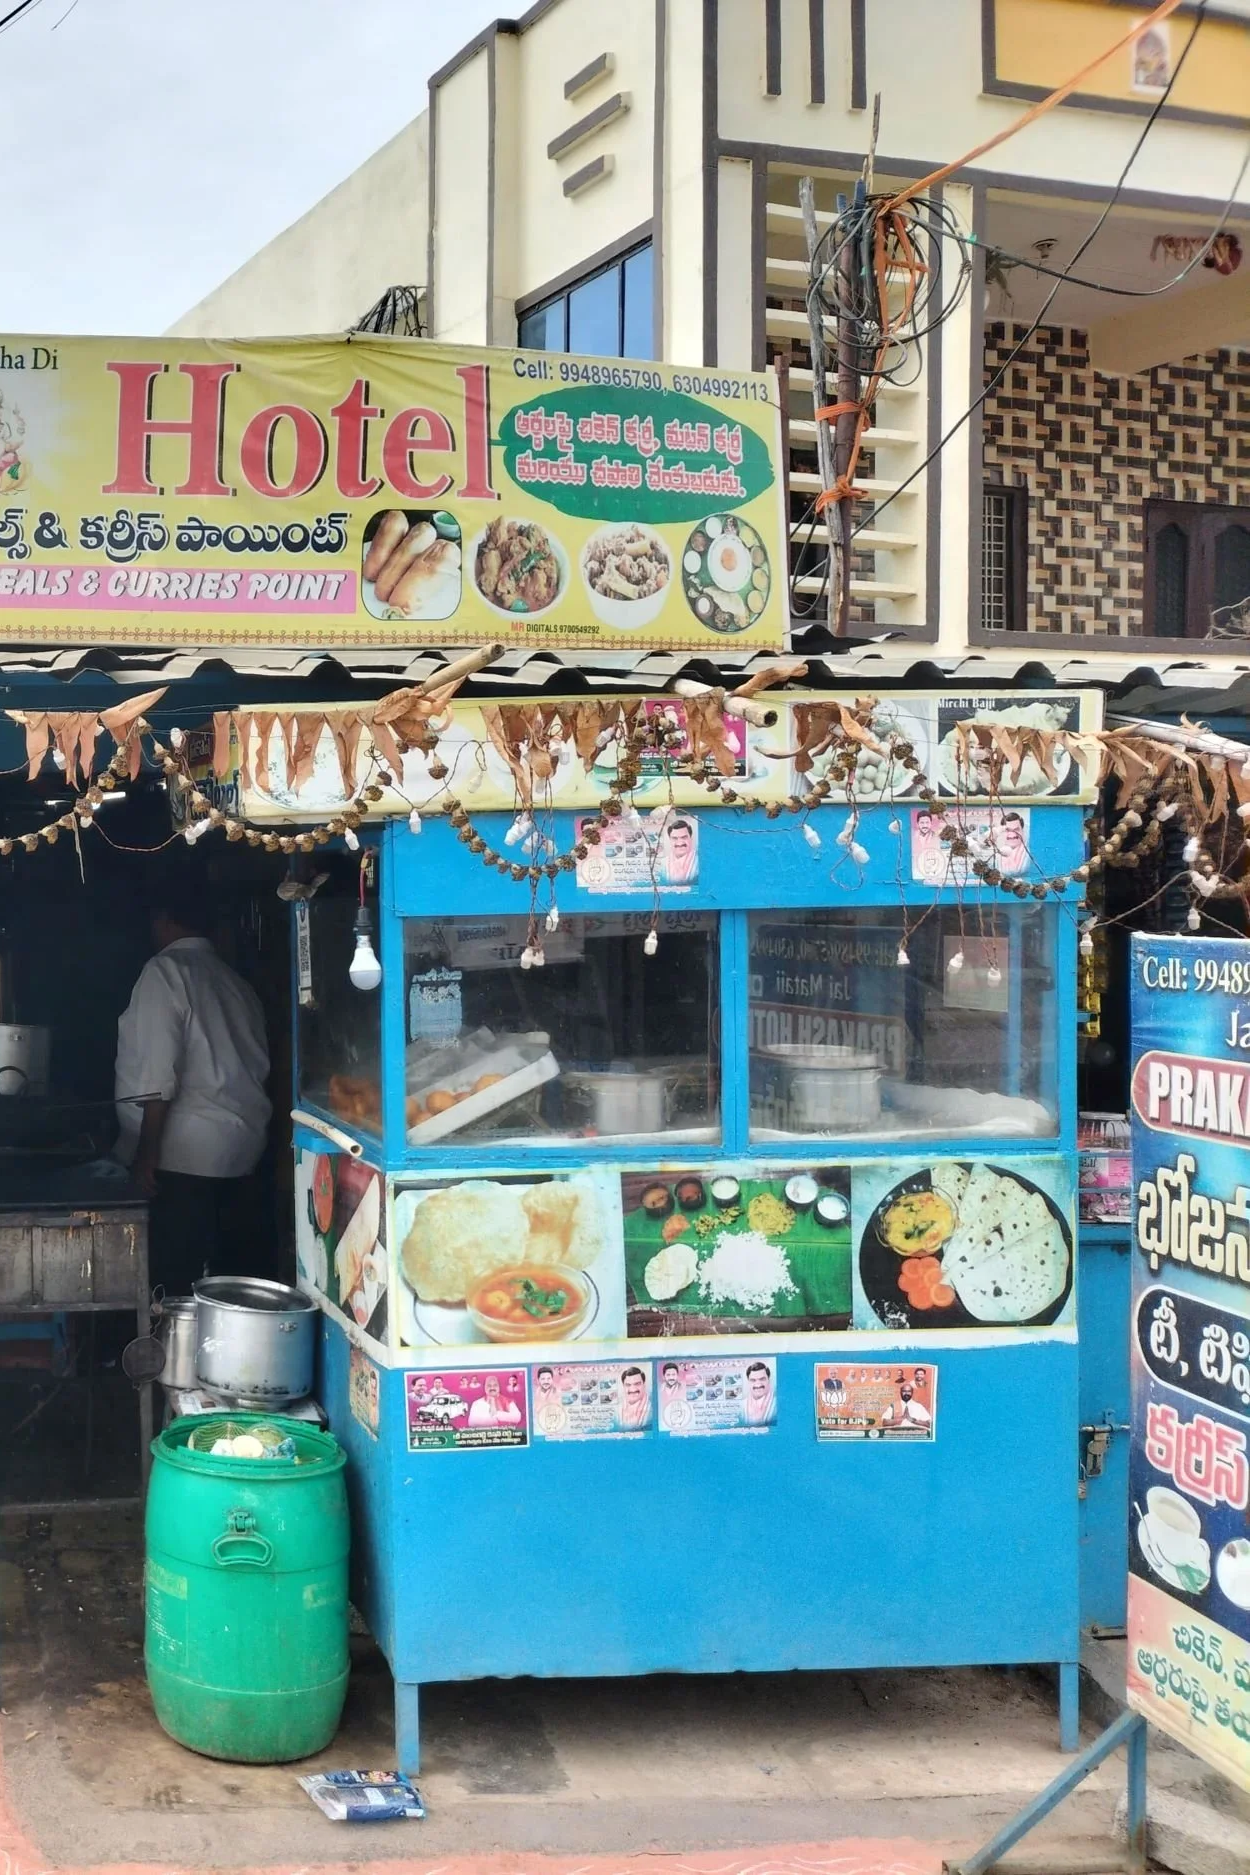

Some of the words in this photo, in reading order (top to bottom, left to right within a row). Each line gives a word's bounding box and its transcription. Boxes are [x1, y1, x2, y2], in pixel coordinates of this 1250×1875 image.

[31, 347, 59, 370] Di
[513, 358, 554, 380] Cell:
[559, 362, 668, 395] 9948965790,
[673, 374, 769, 402] 6304992113
[101, 361, 502, 500] Hotel
[33, 511, 70, 550] &
[78, 570, 101, 597] &
[107, 570, 242, 601] CURRIES
[248, 573, 348, 601] POINT
[526, 623, 558, 633] DIGITALS
[1143, 956, 1188, 990] Cell:
[1149, 1062, 1250, 1137] PRAK
